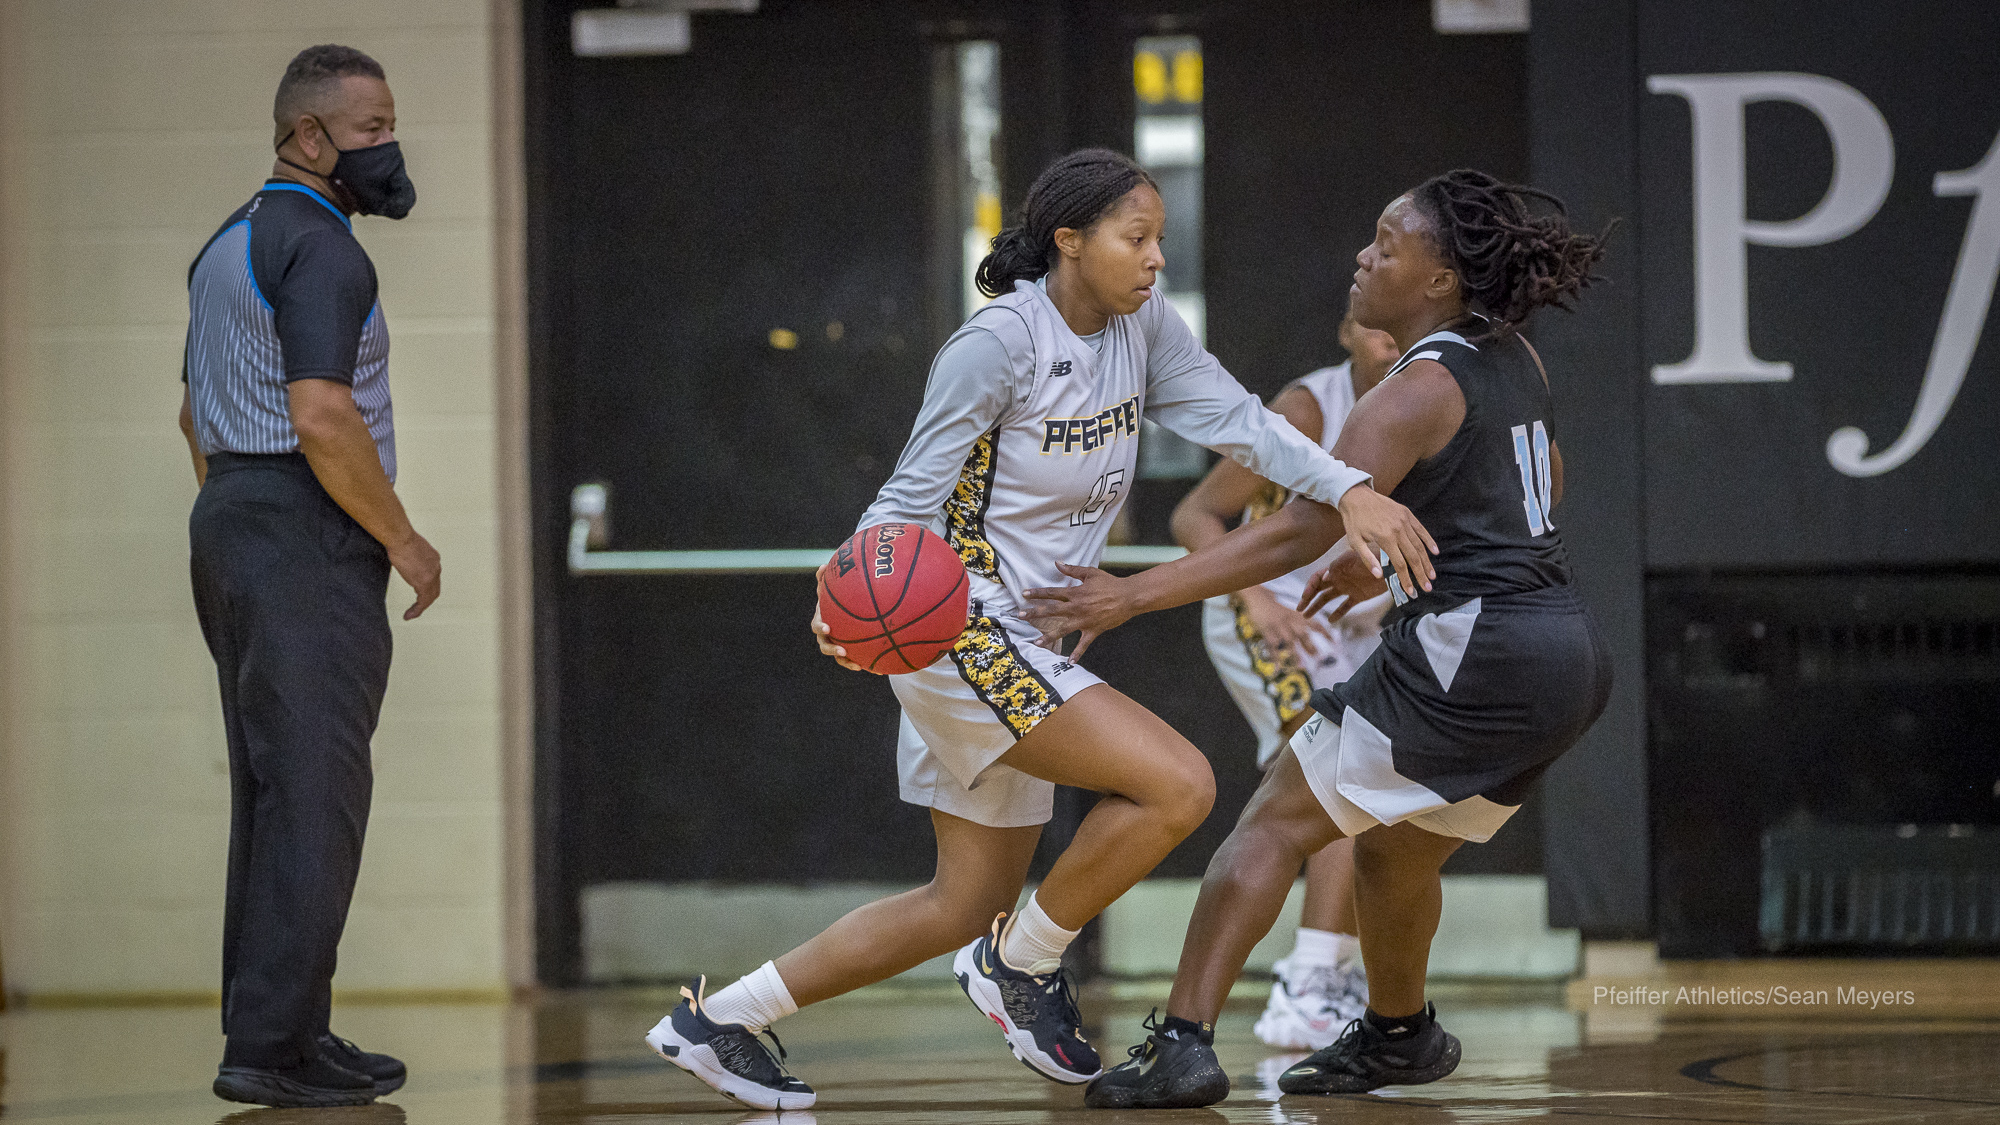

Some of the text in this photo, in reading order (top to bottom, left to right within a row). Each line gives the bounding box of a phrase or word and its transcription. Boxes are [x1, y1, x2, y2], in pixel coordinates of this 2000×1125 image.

[1070, 469, 1125, 527] 15
[1511, 420, 1555, 537] 10
[875, 522, 905, 579] ilson
